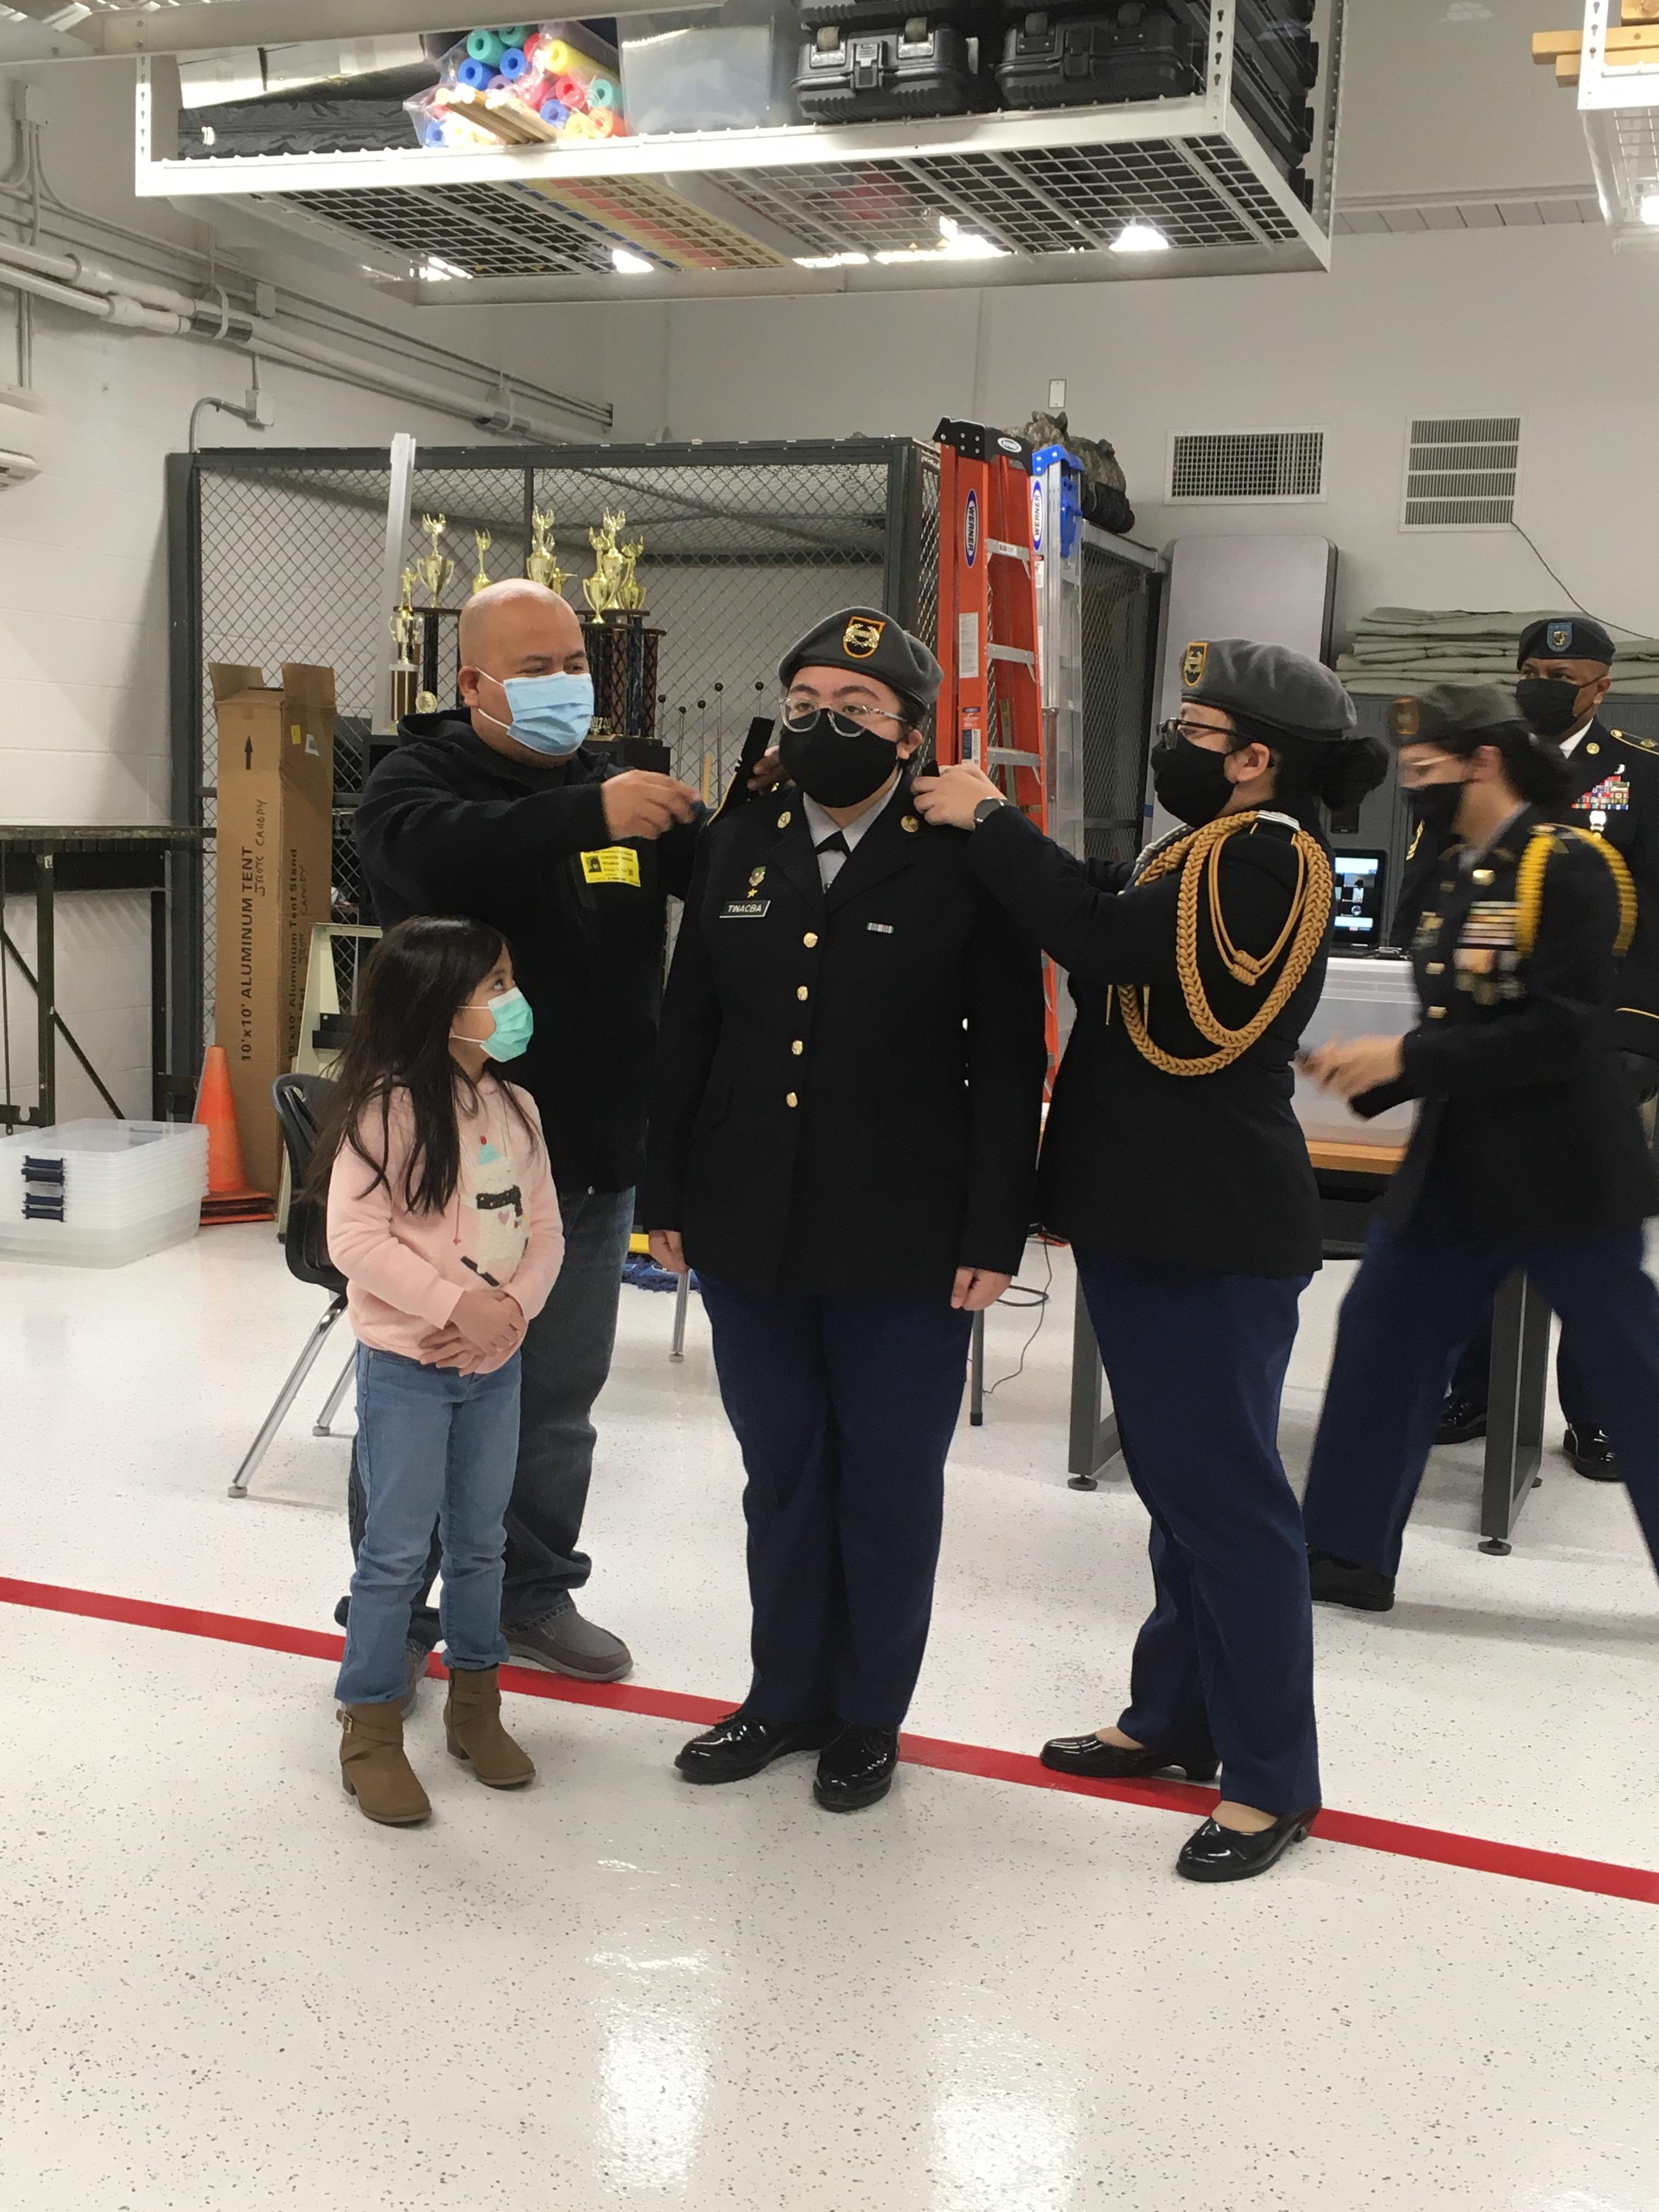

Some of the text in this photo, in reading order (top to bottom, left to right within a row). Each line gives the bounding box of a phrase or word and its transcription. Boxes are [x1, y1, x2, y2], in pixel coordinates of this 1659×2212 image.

[255, 855, 266, 897] JROTC
[290, 849, 298, 891] Stand
[727, 904, 762, 913] TINACBA
[241, 845, 253, 1062] 10'x10' ALUMINUM TENT
